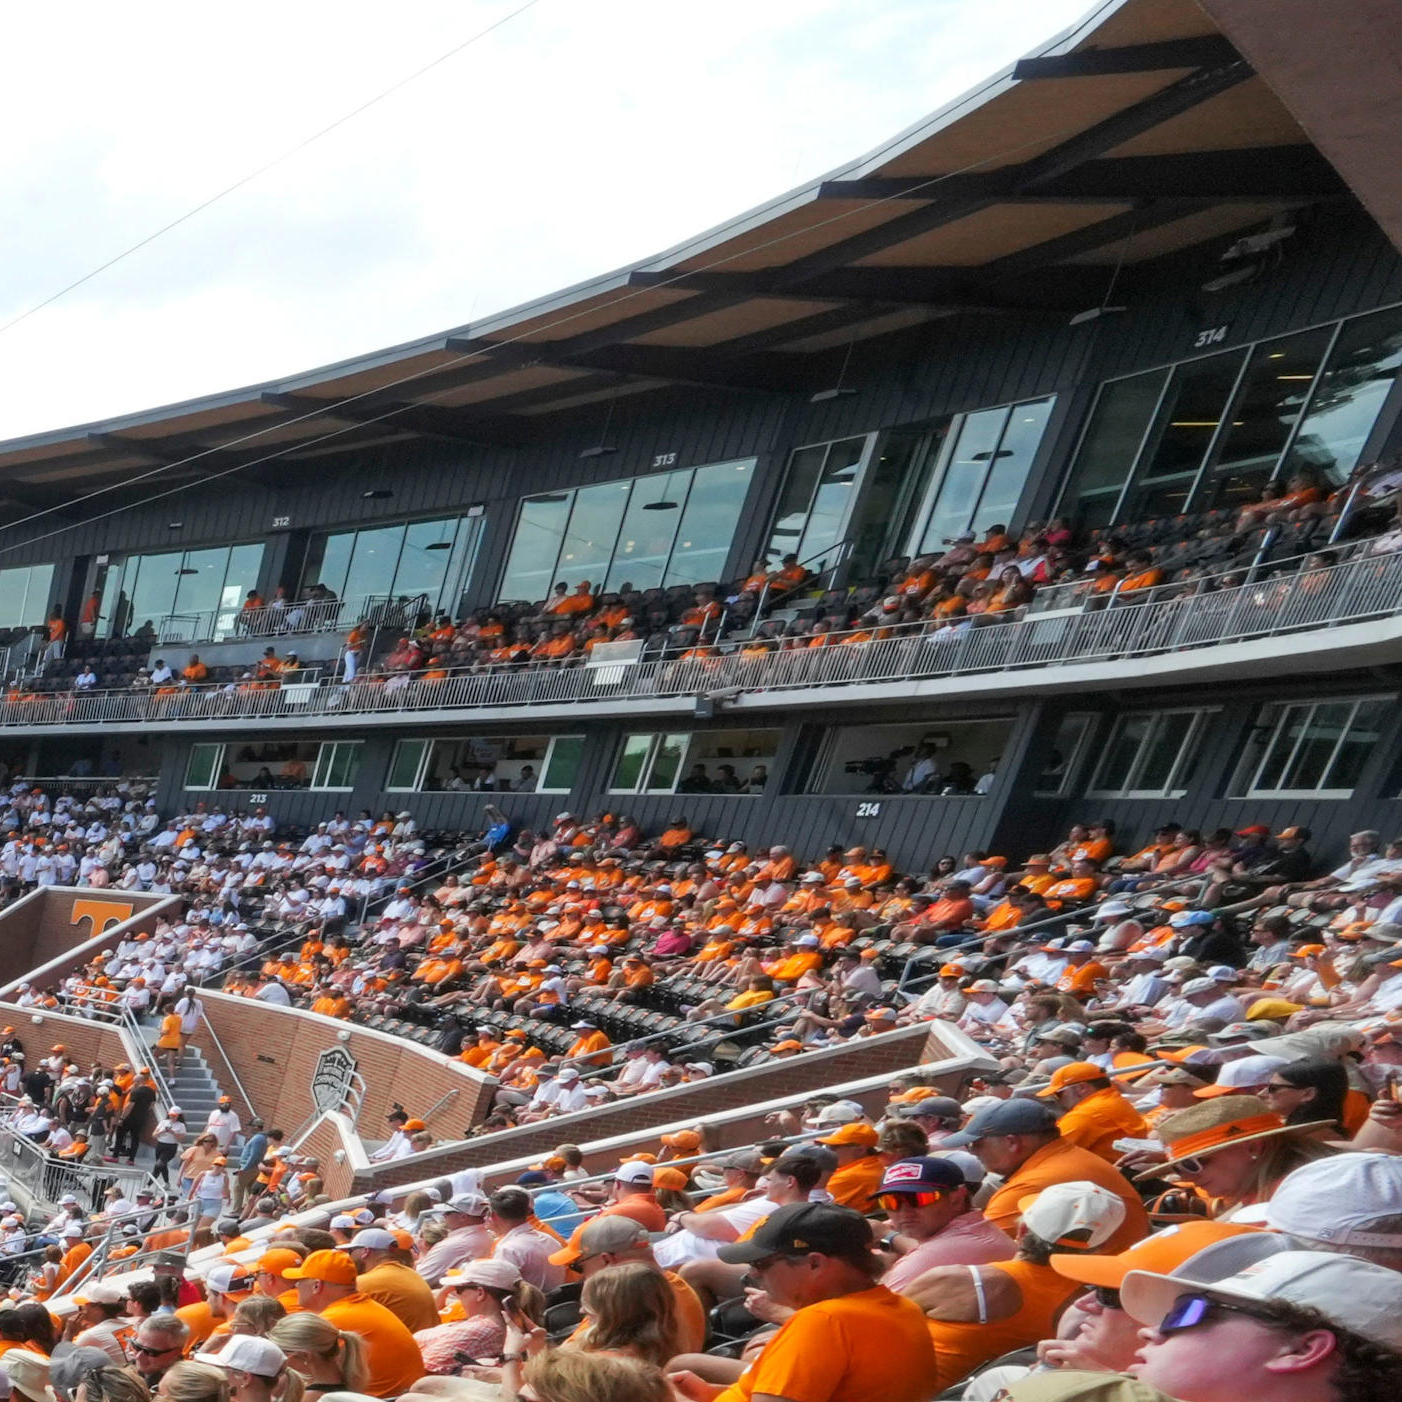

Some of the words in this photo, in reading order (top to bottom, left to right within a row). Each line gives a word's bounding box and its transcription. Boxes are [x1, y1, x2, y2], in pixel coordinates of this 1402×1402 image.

[1194, 327, 1228, 348] 314
[653, 453, 676, 468] 313
[272, 517, 289, 527] 312
[250, 793, 268, 803] 213
[856, 802, 881, 817] 214
[70, 899, 134, 940] T
